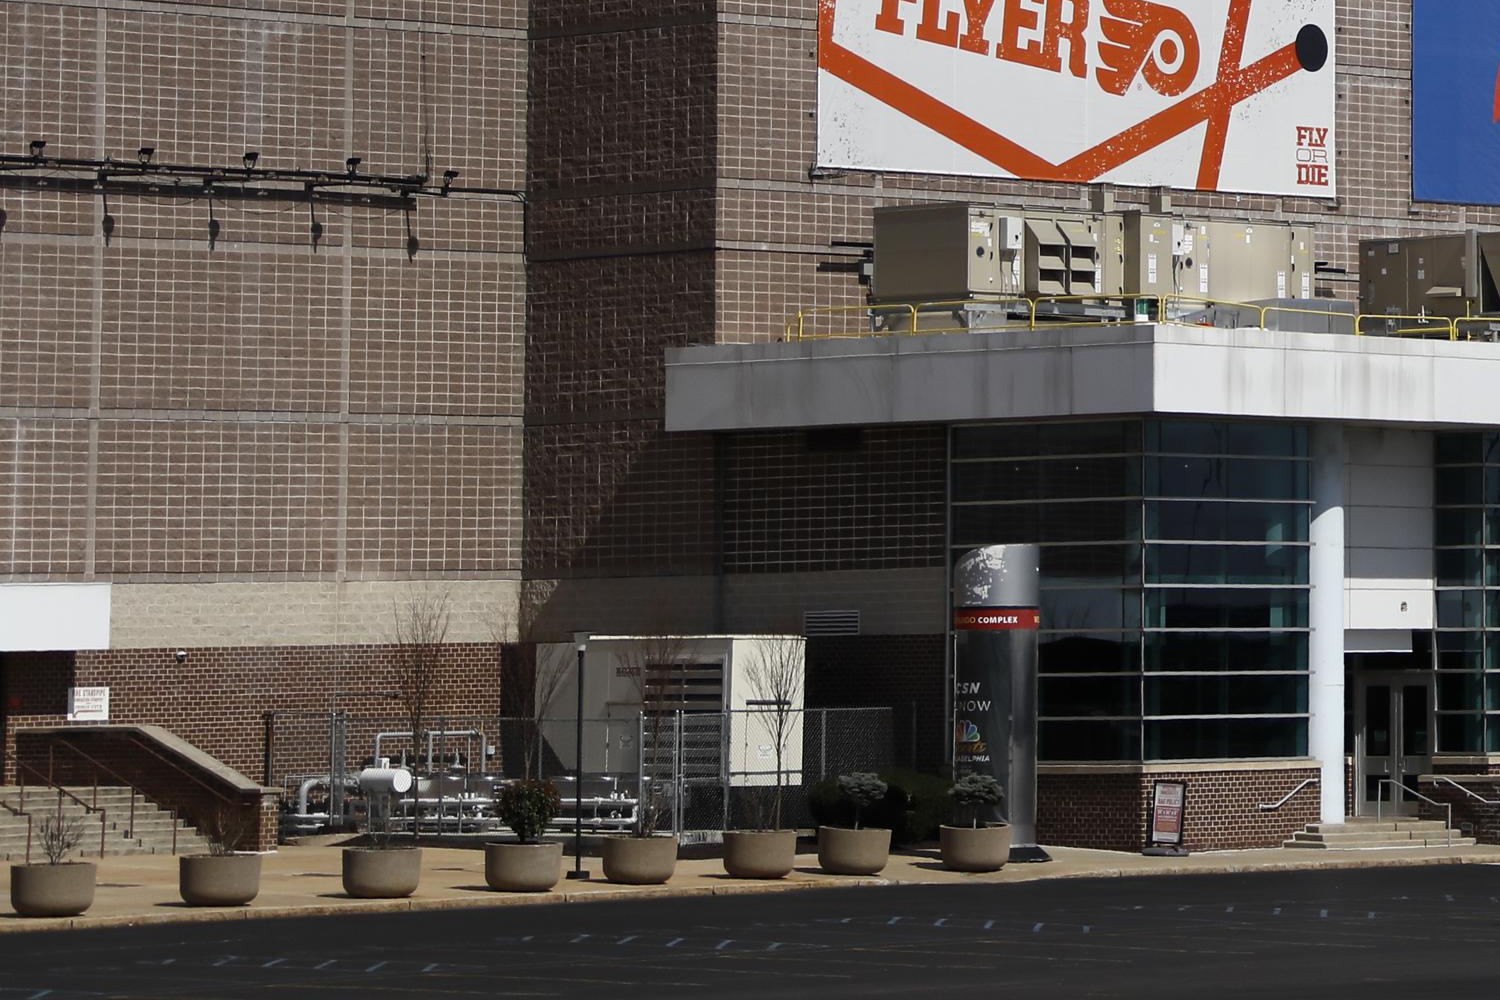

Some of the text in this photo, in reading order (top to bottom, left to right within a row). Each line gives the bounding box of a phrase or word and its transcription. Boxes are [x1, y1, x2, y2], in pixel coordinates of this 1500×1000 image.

[1296, 126, 1328, 147] FLY
[1296, 148, 1328, 163] OR
[1296, 164, 1328, 186] DIE
[977, 616, 1018, 624] COMPLEX
